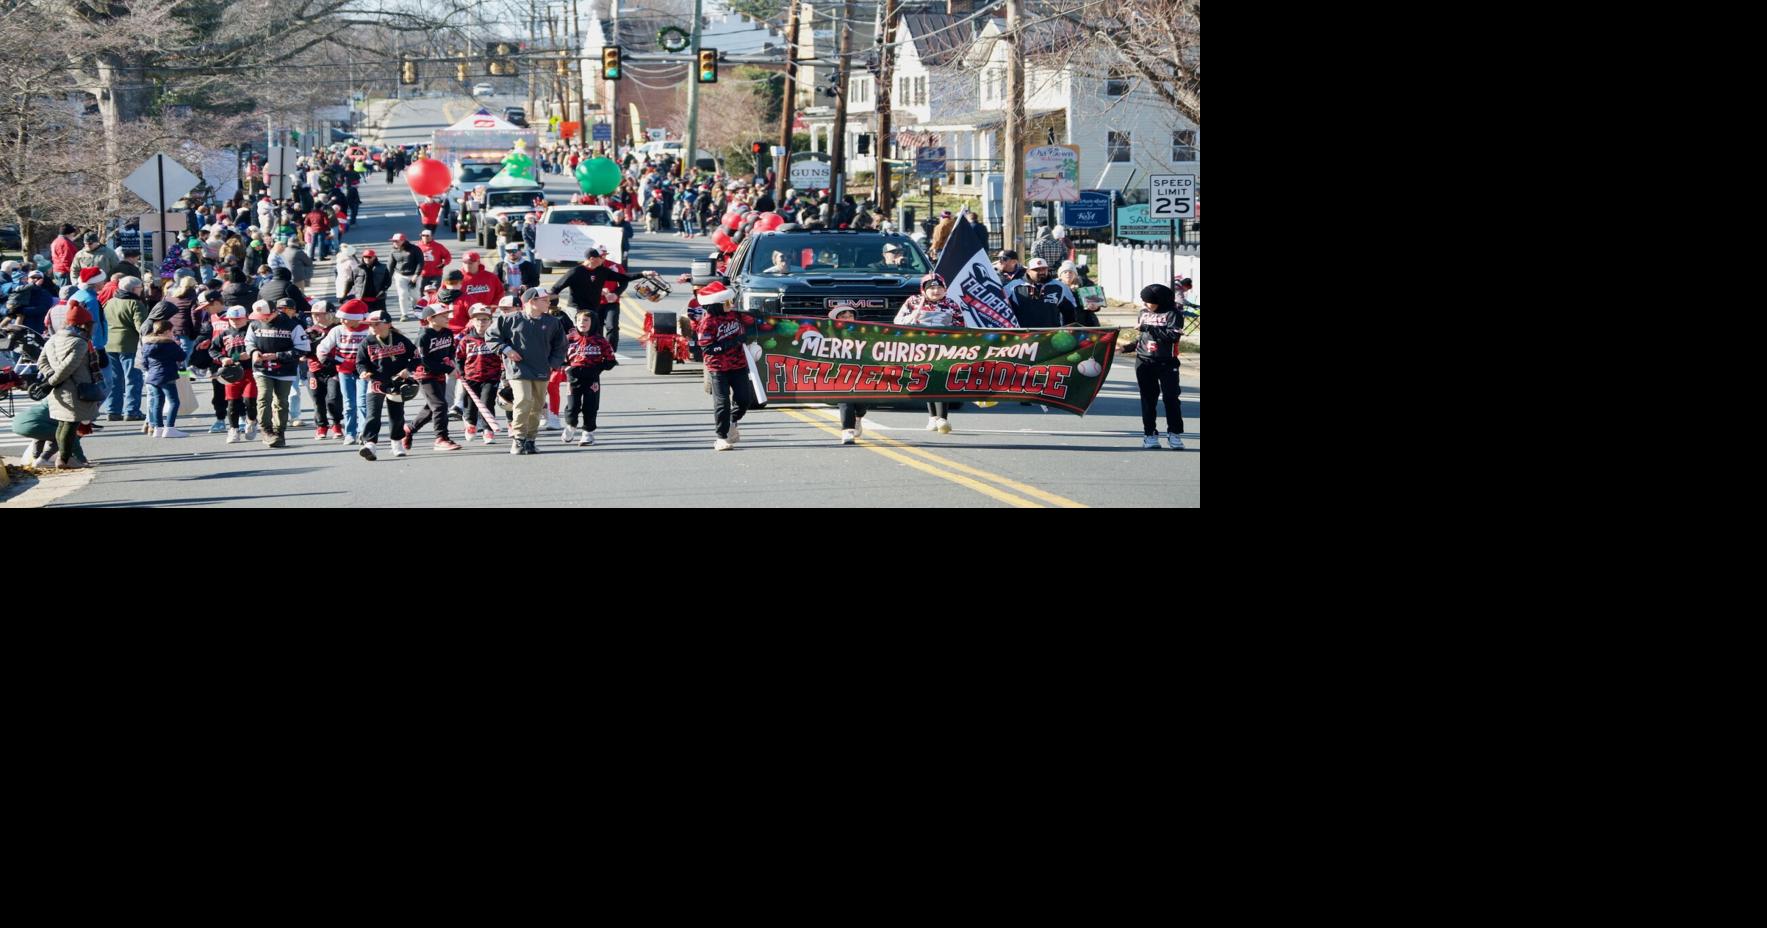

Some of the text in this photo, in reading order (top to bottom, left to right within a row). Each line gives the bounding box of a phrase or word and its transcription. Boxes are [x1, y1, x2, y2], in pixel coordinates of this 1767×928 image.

[791, 168, 830, 177] GUNS
[1153, 179, 1192, 187] SPEED
[1157, 188, 1188, 196] LIMIT
[1155, 197, 1191, 214] 25
[1129, 215, 1168, 224] SALON
[962, 278, 1013, 318] FIELDER'S
[828, 299, 885, 308] GMC
[800, 336, 1039, 363] MERRY CHRISTMAS FROM
[765, 354, 1073, 400] FIELDER'S CHOICE
